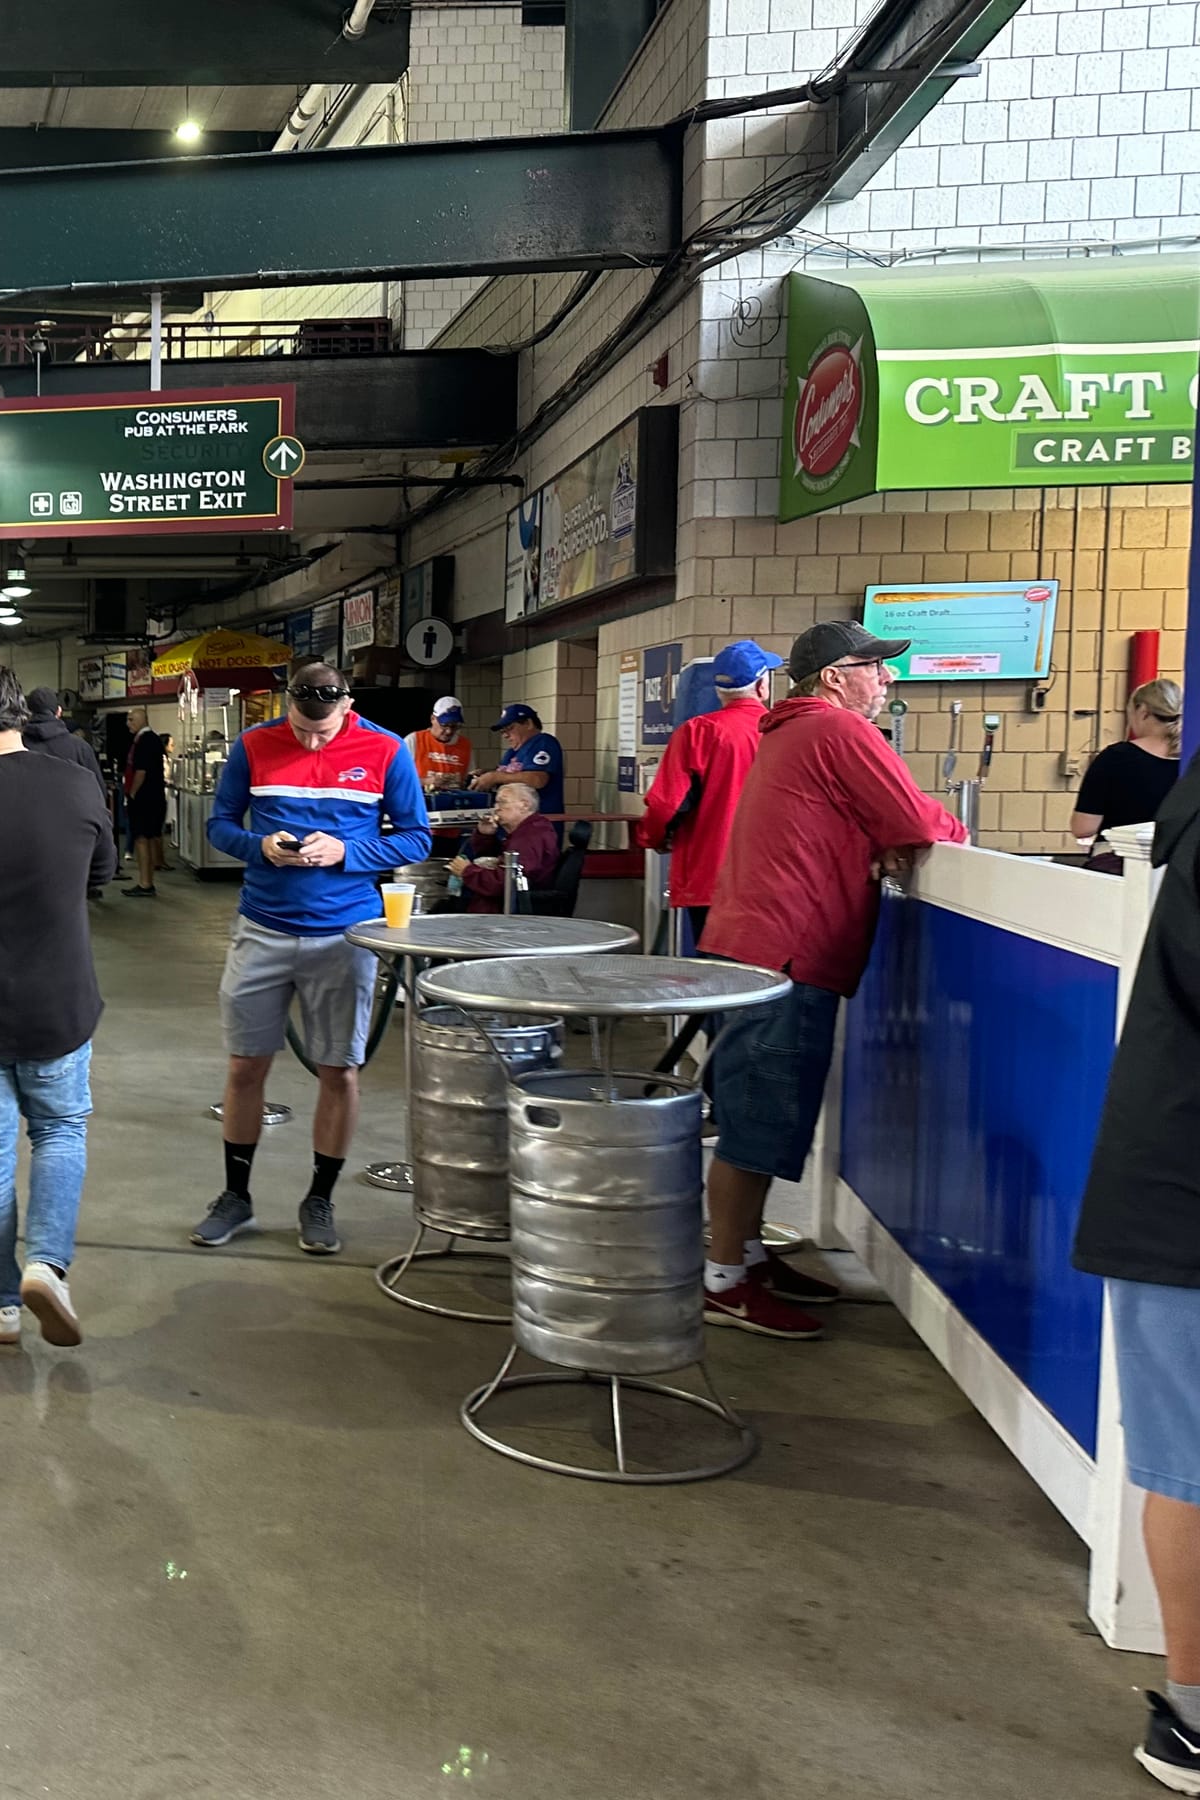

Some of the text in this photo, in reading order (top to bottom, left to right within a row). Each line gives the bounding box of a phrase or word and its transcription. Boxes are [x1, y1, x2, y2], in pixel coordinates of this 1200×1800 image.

[904, 371, 1164, 425] CRAFT
[136, 408, 238, 426] CONSUMERS
[124, 422, 249, 438] PUB AT THE PARK
[1032, 437, 1156, 463] CRAFT
[100, 470, 246, 491] WASHINGTON
[109, 490, 246, 512] STREET EXIT
[153, 663, 167, 675] HOT
[198, 657, 222, 668] HOT
[226, 655, 261, 666] DOGS
